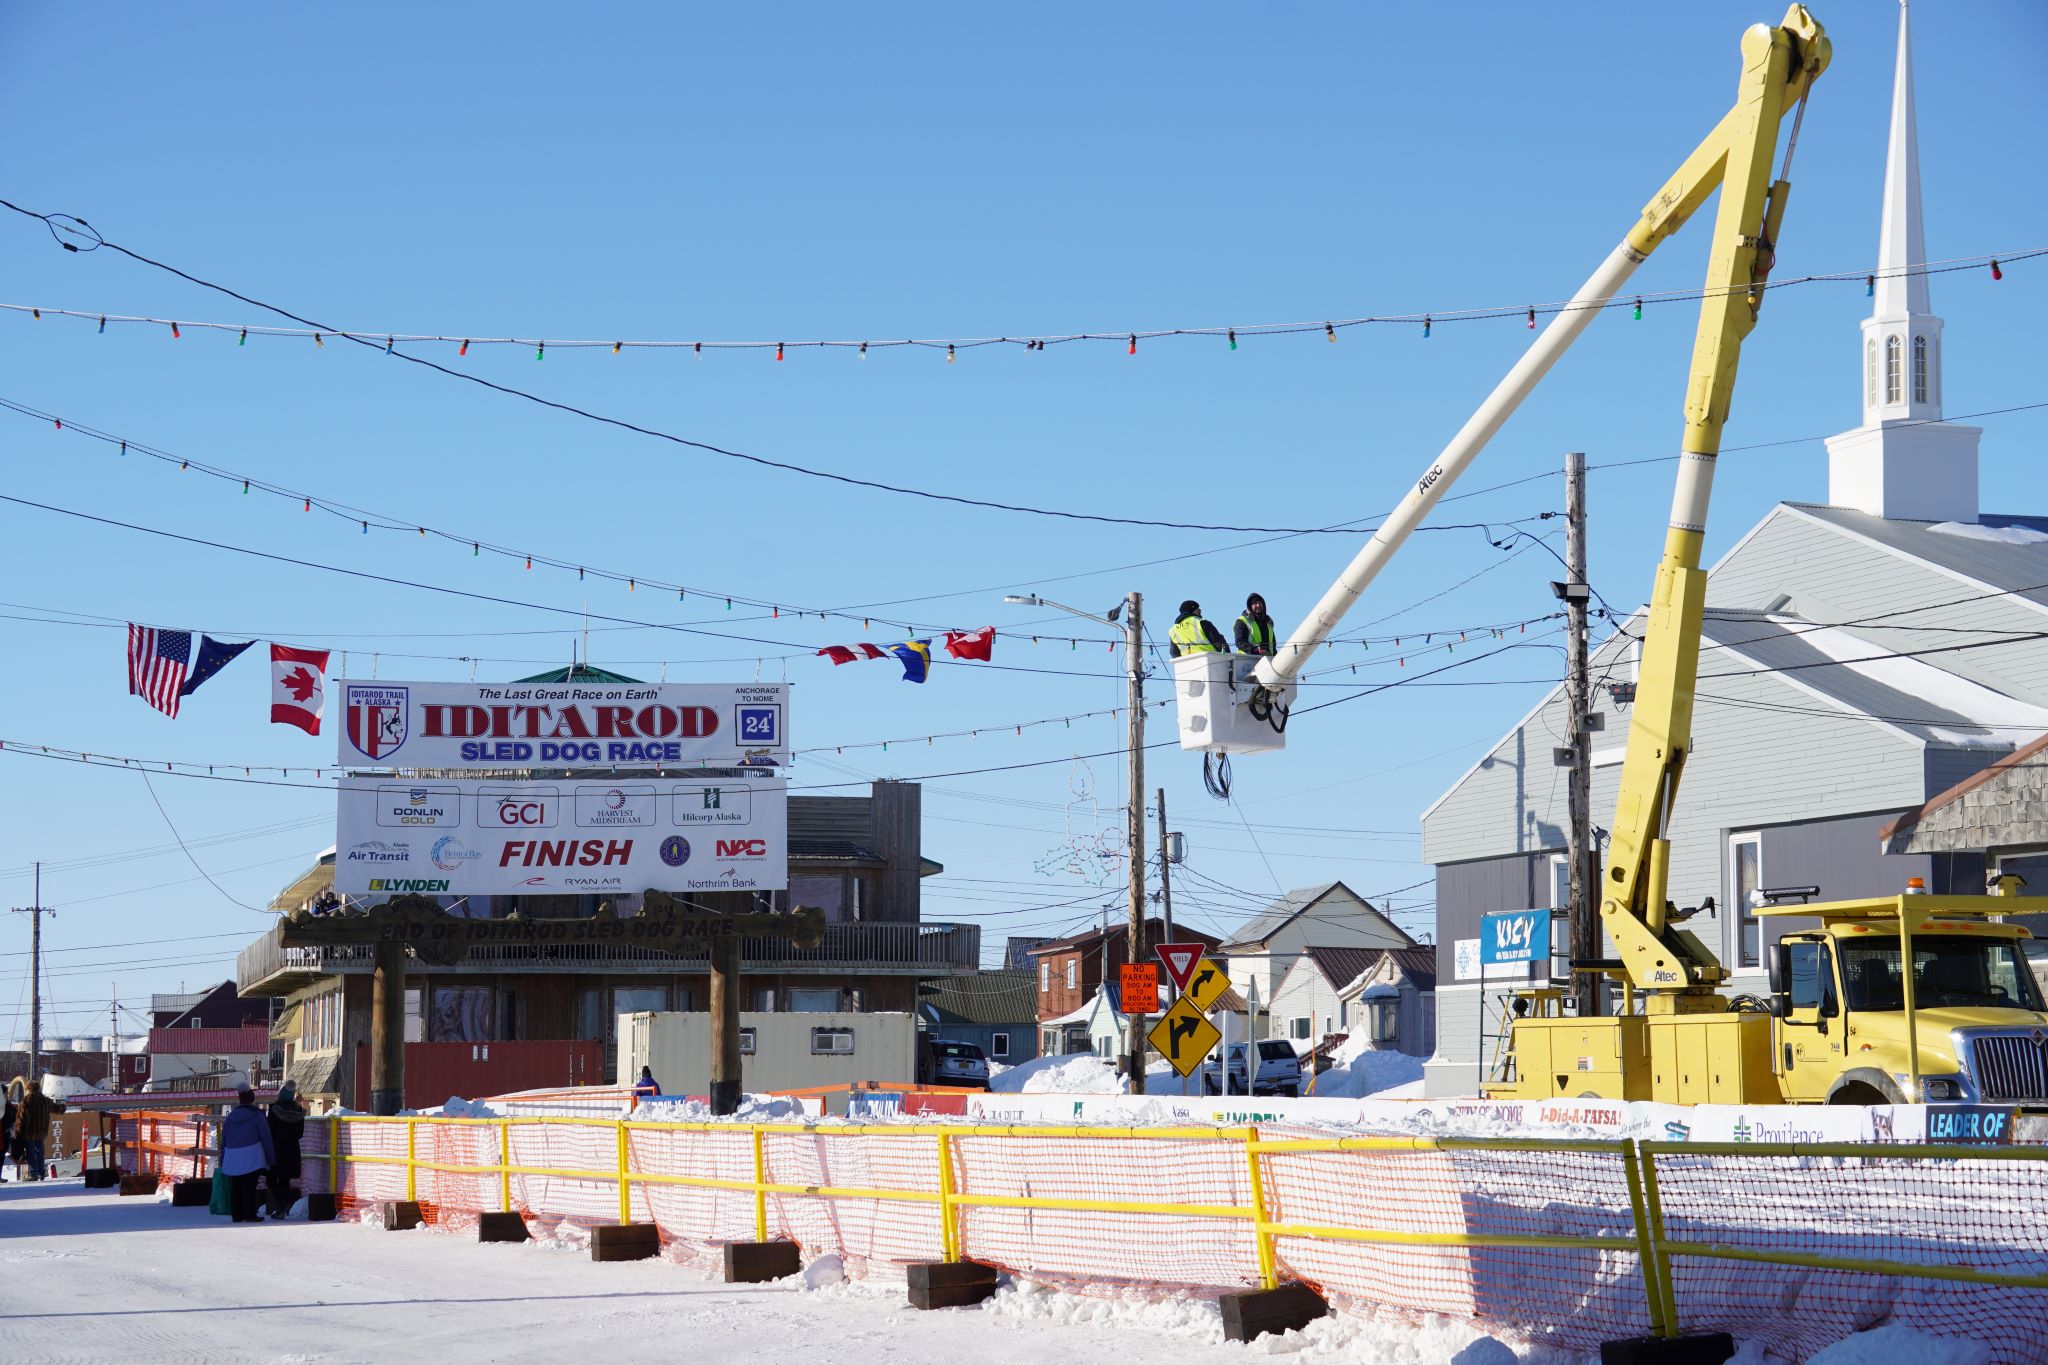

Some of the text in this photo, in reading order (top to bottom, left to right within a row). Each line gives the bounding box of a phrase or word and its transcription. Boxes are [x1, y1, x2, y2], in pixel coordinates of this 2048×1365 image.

[1419, 464, 1442, 495] Altec
[351, 690, 405, 699] IDITAROD TRAIL
[479, 689, 501, 699] The
[505, 689, 531, 699] Last
[535, 689, 569, 700] Great
[572, 689, 603, 700] Race
[606, 692, 621, 700] on
[420, 703, 719, 738] IDITAROD
[460, 741, 681, 761] SLED DOG RACE
[393, 808, 443, 816] DONLIN
[499, 803, 545, 825] GCI
[682, 813, 742, 822] Hilcorp Alaska
[401, 817, 436, 825] GOLD
[590, 817, 641, 825] MIDSTREAM
[498, 839, 634, 867] FINISH
[716, 839, 766, 856] NAC
[348, 851, 410, 861] Air Transit
[384, 879, 450, 891] LYNDEN
[601, 877, 621, 885] AIR
[688, 878, 757, 888] Northrim Bank
[380, 918, 735, 941] END OF IDITAROD SLED DOG RACE
[1655, 971, 1677, 982] Altec
[1930, 1112, 2006, 1138] LEADER OF
